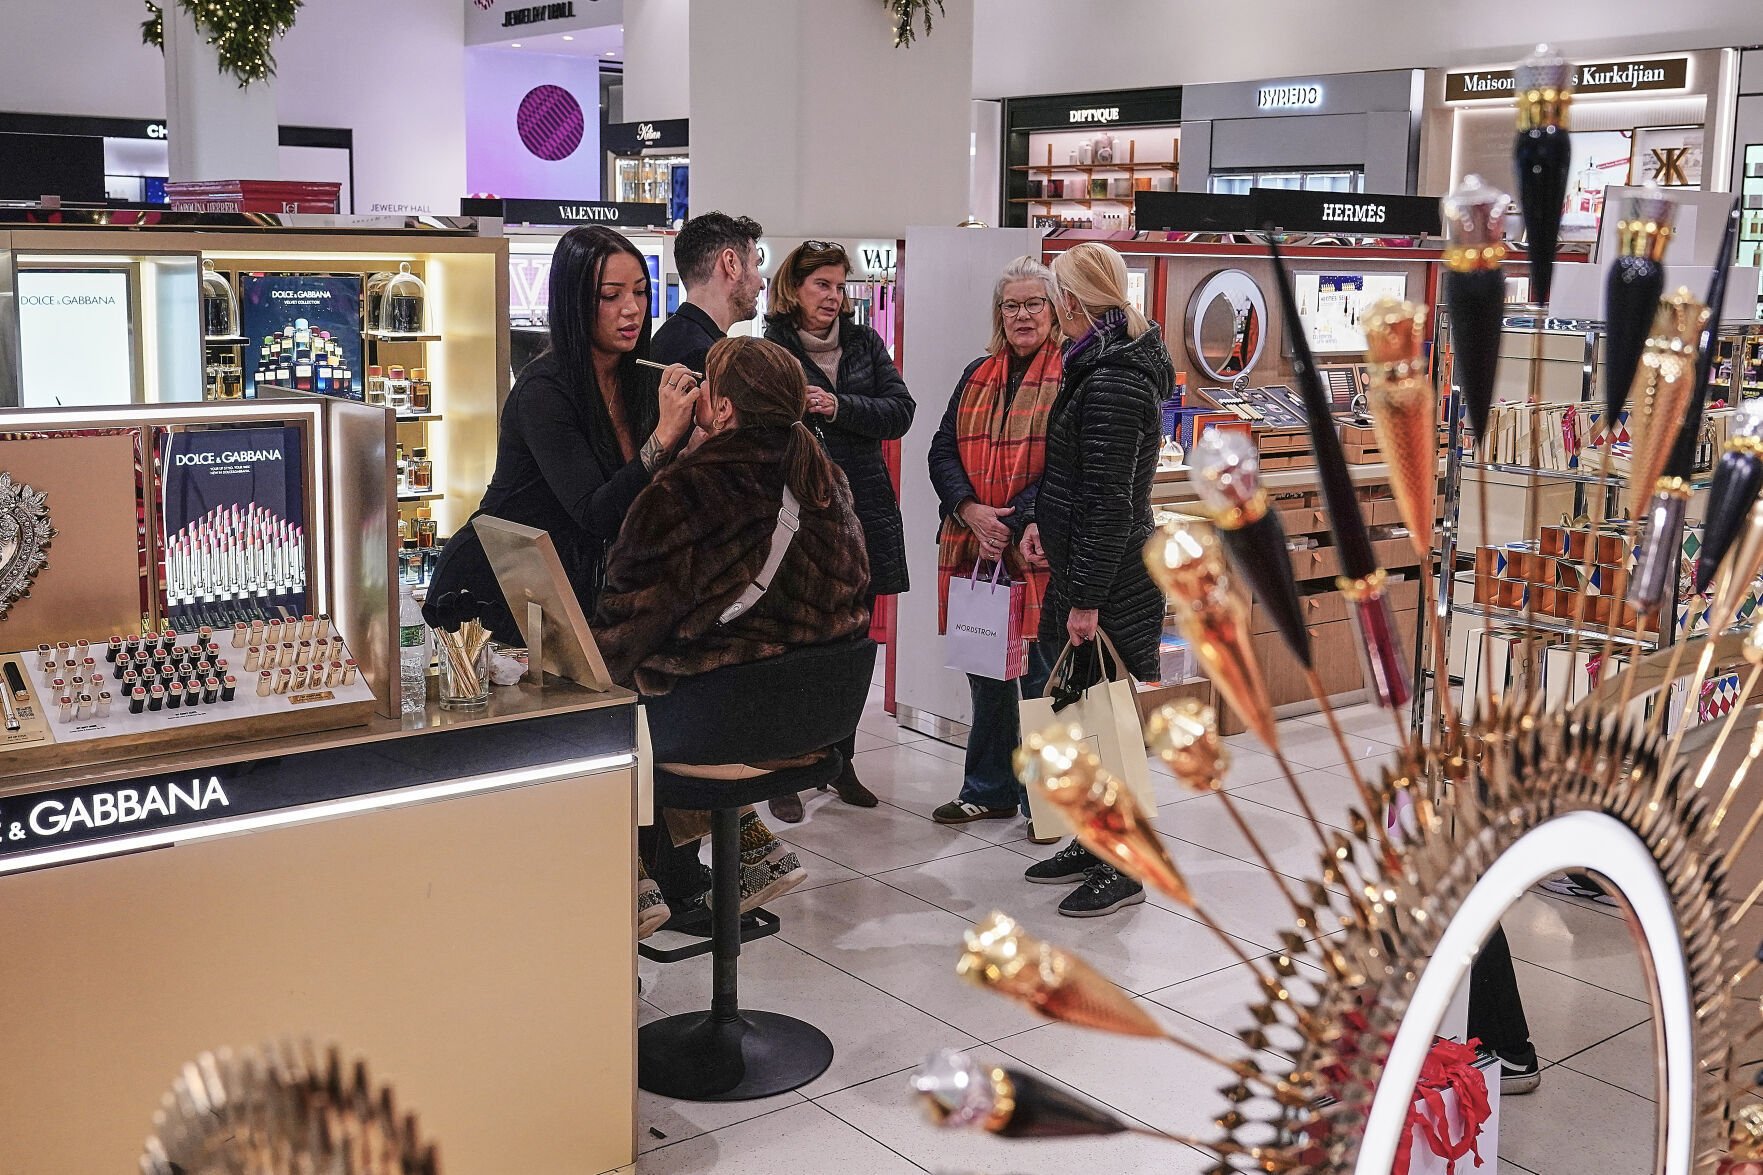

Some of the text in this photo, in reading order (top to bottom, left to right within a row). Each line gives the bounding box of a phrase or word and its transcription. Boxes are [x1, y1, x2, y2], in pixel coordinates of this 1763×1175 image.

[1463, 74, 1516, 92] Maison
[1581, 64, 1665, 89] Kurkdjian
[1257, 87, 1318, 107] BYREDO
[1069, 108, 1120, 123] DIPTYQUE
[370, 203, 431, 213] JEWELRY HALL
[559, 205, 619, 221] VALENTINO
[1322, 203, 1386, 223] HERMÈS
[863, 249, 896, 269] VAL
[20, 295, 55, 306] DOLCE
[62, 295, 116, 305] GABBANA
[272, 290, 294, 298] DOLCE
[176, 452, 215, 466] DOLCE
[222, 449, 282, 464] GABBANA
[955, 623, 997, 637] NORDSTROM
[8, 821, 26, 841] &
[29, 776, 230, 836] GABBANA
